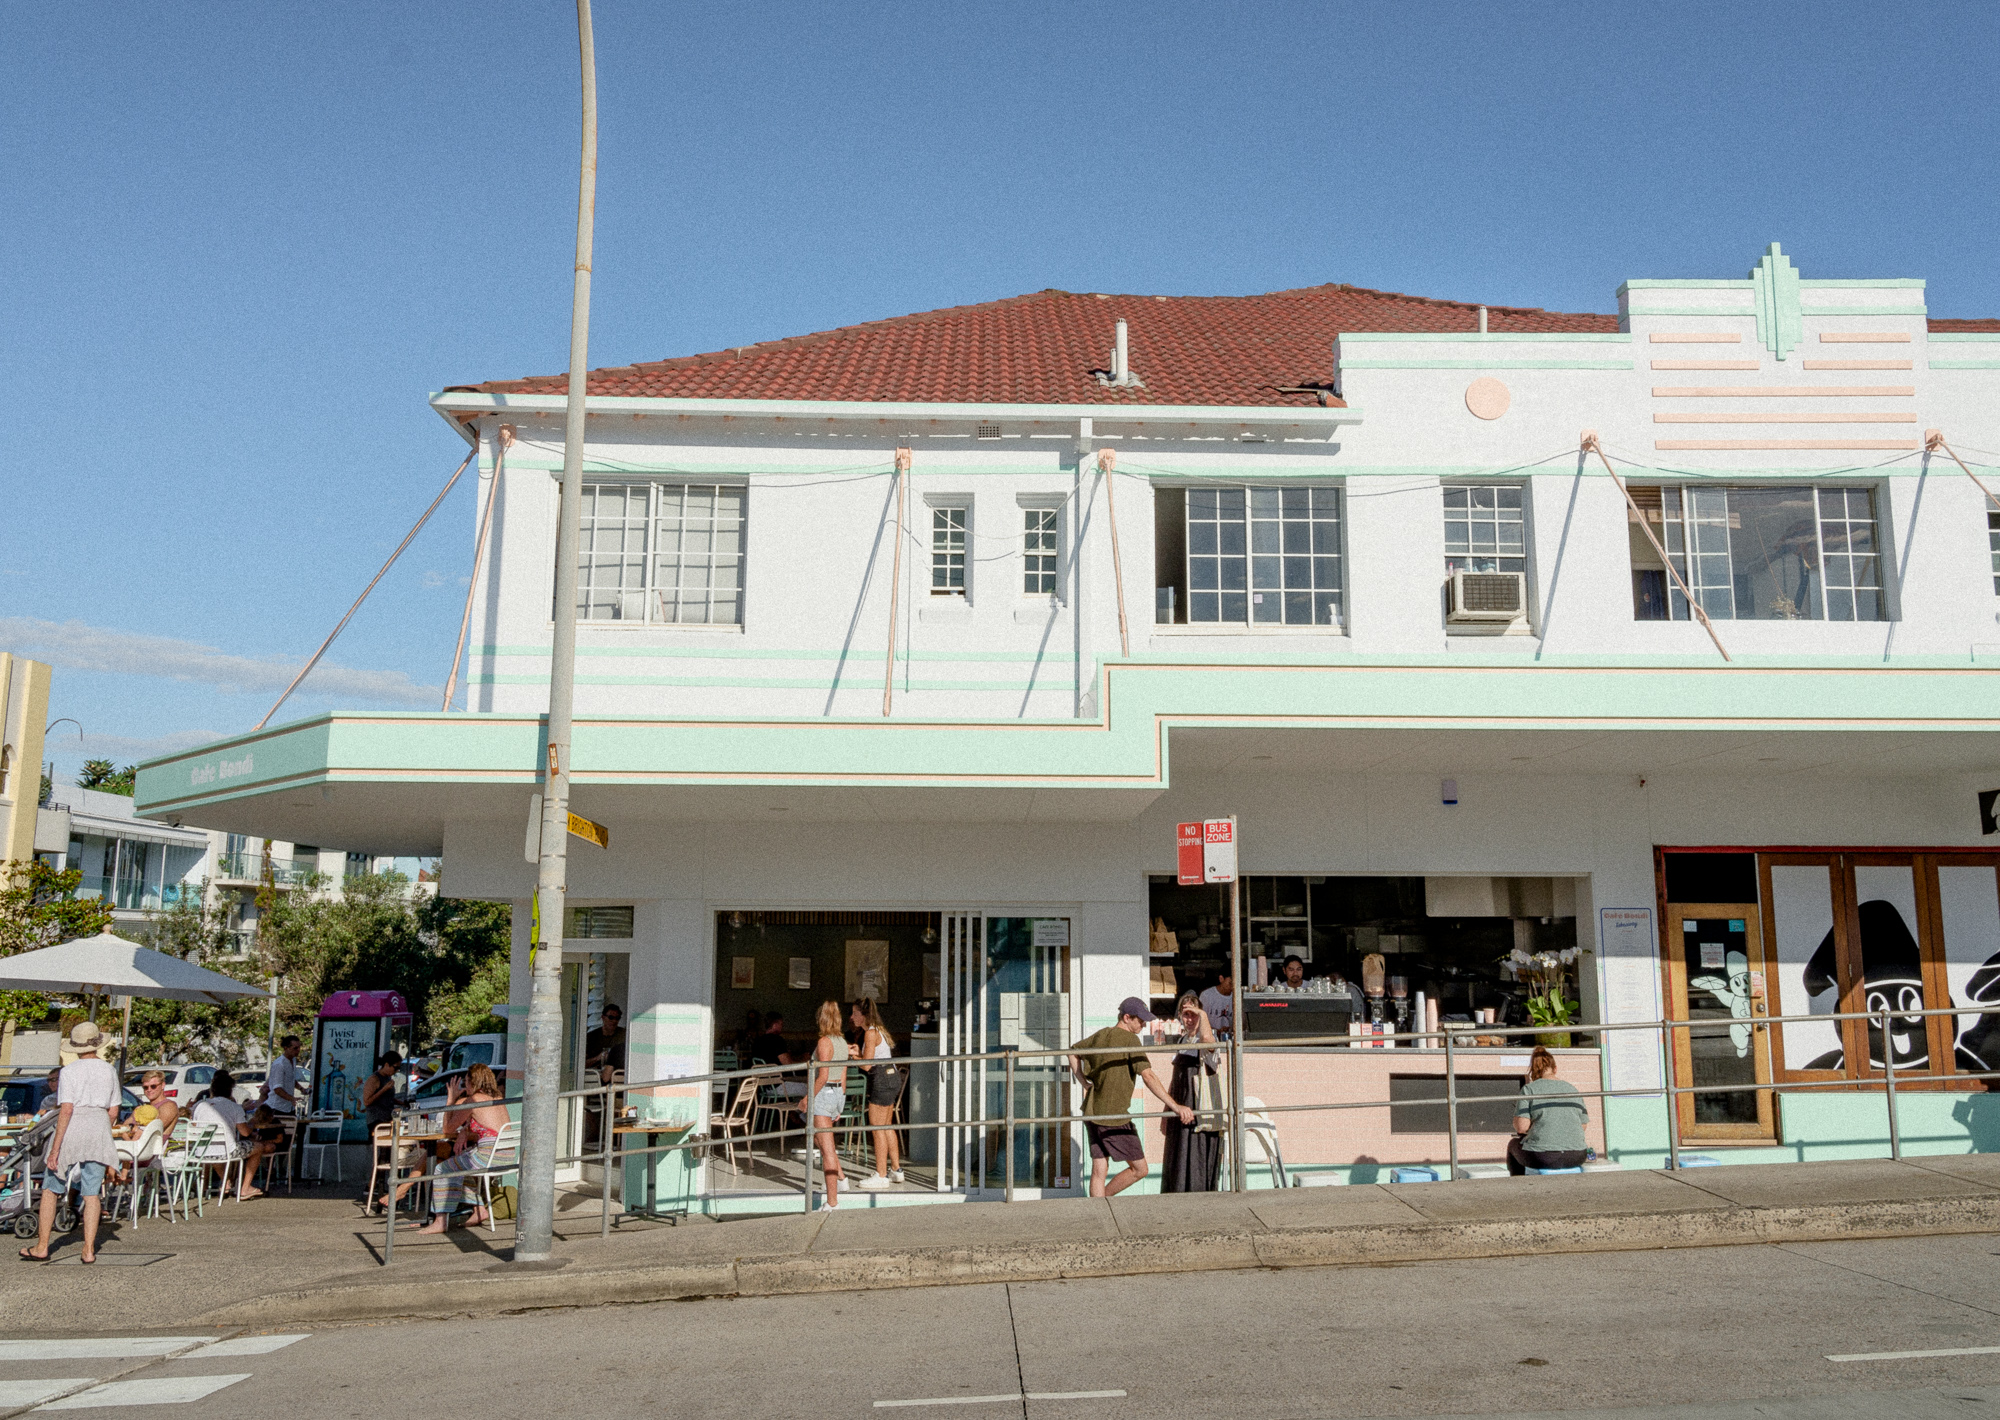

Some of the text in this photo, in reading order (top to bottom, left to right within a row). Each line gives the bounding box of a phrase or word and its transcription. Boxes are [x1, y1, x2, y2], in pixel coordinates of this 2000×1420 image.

[219, 753, 254, 779] Bondi
[1185, 826, 1196, 836] NO
[1209, 824, 1228, 833] BUS
[1206, 833, 1231, 842] ZONE
[329, 1028, 355, 1038] Twist
[333, 1038, 370, 1050] & Tonic
